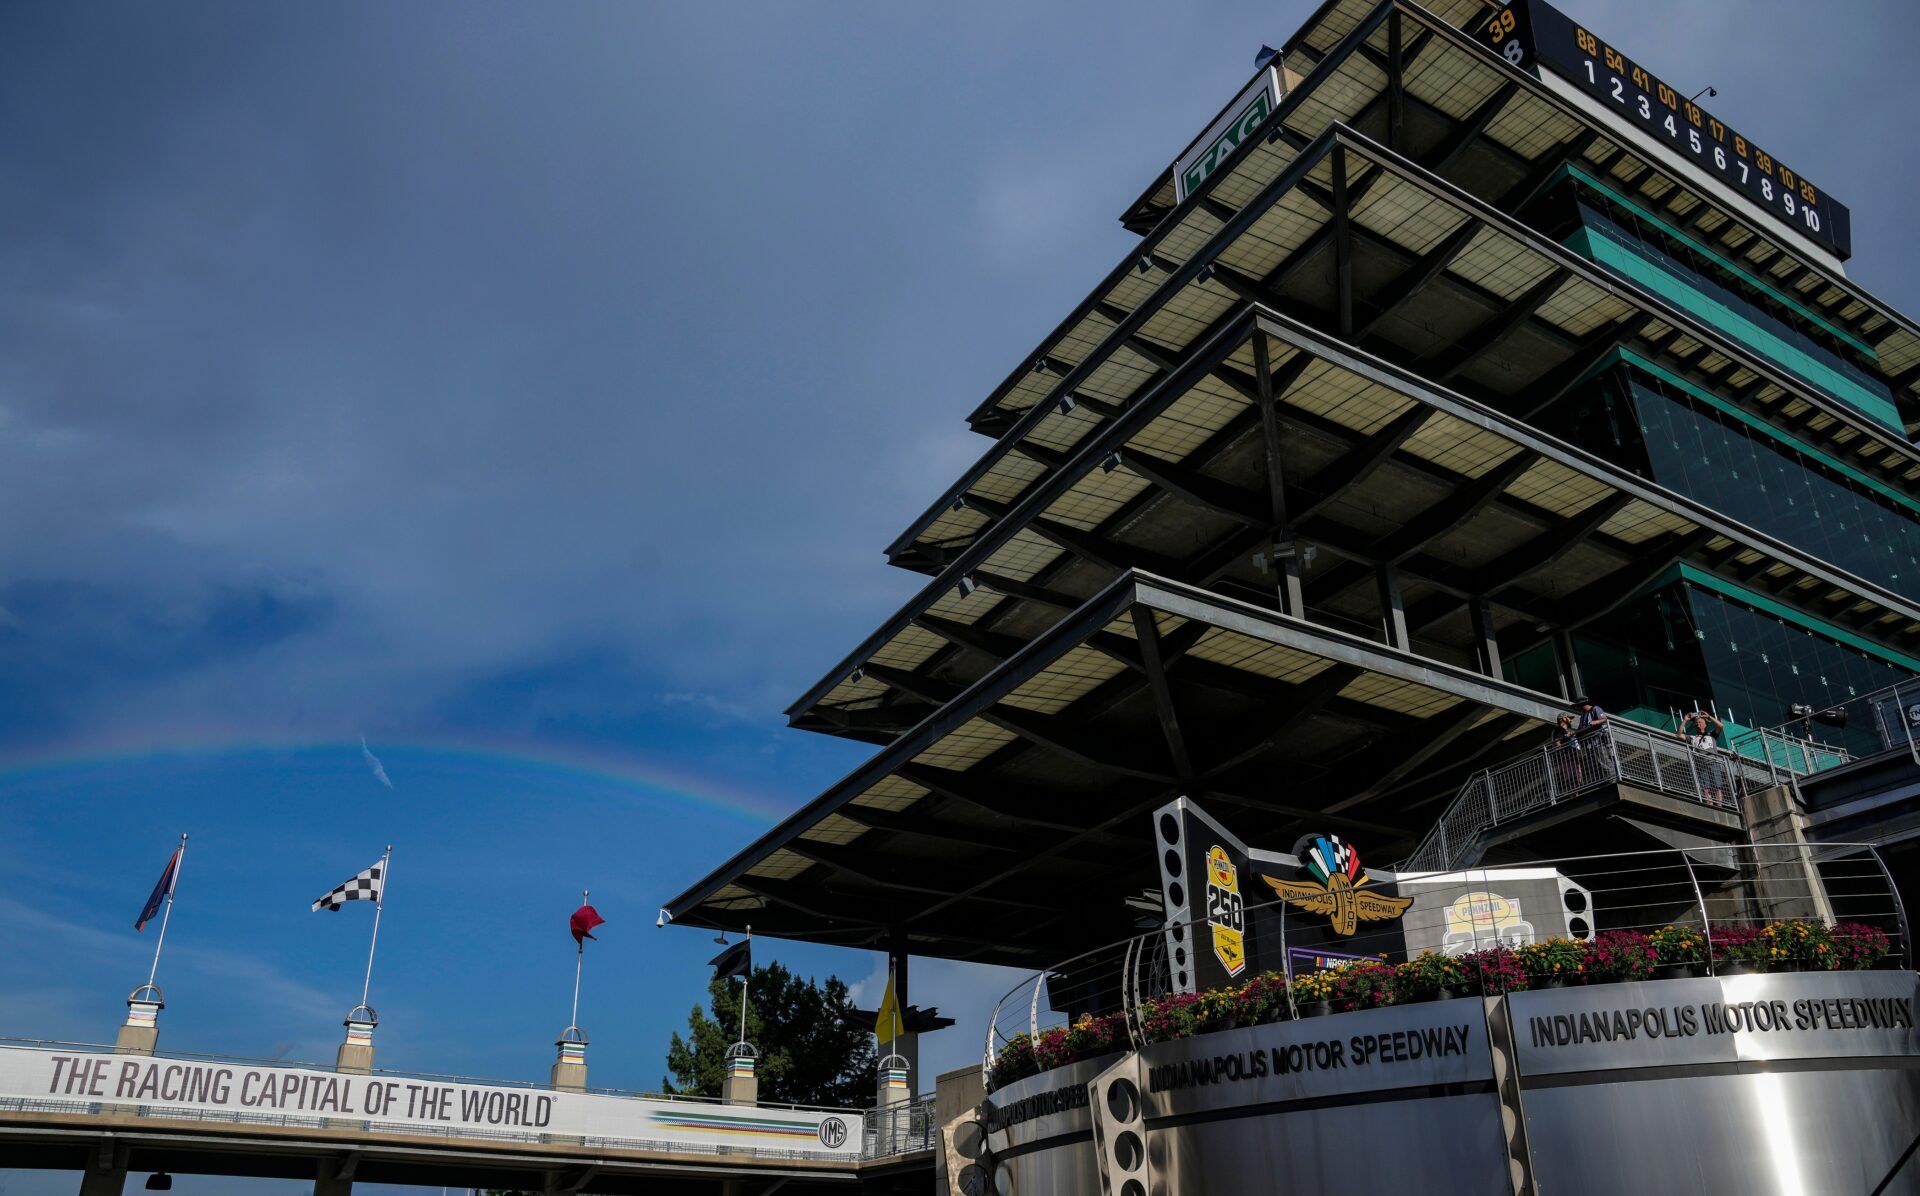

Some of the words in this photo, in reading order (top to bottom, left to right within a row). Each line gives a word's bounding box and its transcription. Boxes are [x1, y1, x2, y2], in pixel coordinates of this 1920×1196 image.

[1488, 9, 1516, 43] 39
[1504, 39, 1523, 64] 8
[1577, 28, 1596, 56] 88
[1605, 47, 1624, 75] 54
[1632, 67, 1650, 92] 41
[1658, 84, 1676, 110] 00
[1685, 101, 1701, 128] 18
[1710, 118, 1724, 142] 17
[1756, 150, 1772, 176] 39
[1780, 166, 1794, 190] 10
[1800, 180, 1816, 204] 26
[1190, 106, 1261, 183] TAG
[1584, 60, 1594, 84] 1
[1610, 77, 1624, 104] 2
[1638, 95, 1650, 120] 3
[1664, 115, 1677, 137] 4
[1690, 128, 1702, 154] 5
[1714, 147, 1726, 170] 6
[1738, 161, 1748, 184] 7
[1761, 178, 1773, 201] 8
[1784, 193, 1795, 216] 9
[1802, 206, 1820, 232] 10
[1209, 884, 1242, 932] 250
[1282, 889, 1333, 905] INDIANAPOLIS
[1342, 881, 1354, 930] MOTOR
[1360, 902, 1396, 914] SPEEDWAY
[1530, 1005, 1698, 1047] INDIANAPOLIS
[1702, 1000, 1793, 1034] MOTOR
[1794, 998, 1914, 1030] SPEEDWAY
[1149, 1050, 1268, 1093] INDIANAPOLIS
[1272, 1040, 1347, 1075] MOTOR
[1351, 1024, 1469, 1065] SPEEDWAY
[50, 1056, 111, 1096] THE
[116, 1061, 232, 1104] RACING
[240, 1071, 354, 1113] CAPITAL
[364, 1081, 399, 1116] OF
[406, 1085, 454, 1120] THE
[1025, 1091, 1056, 1120] MOTOR
[824, 1122, 844, 1144] IMS
